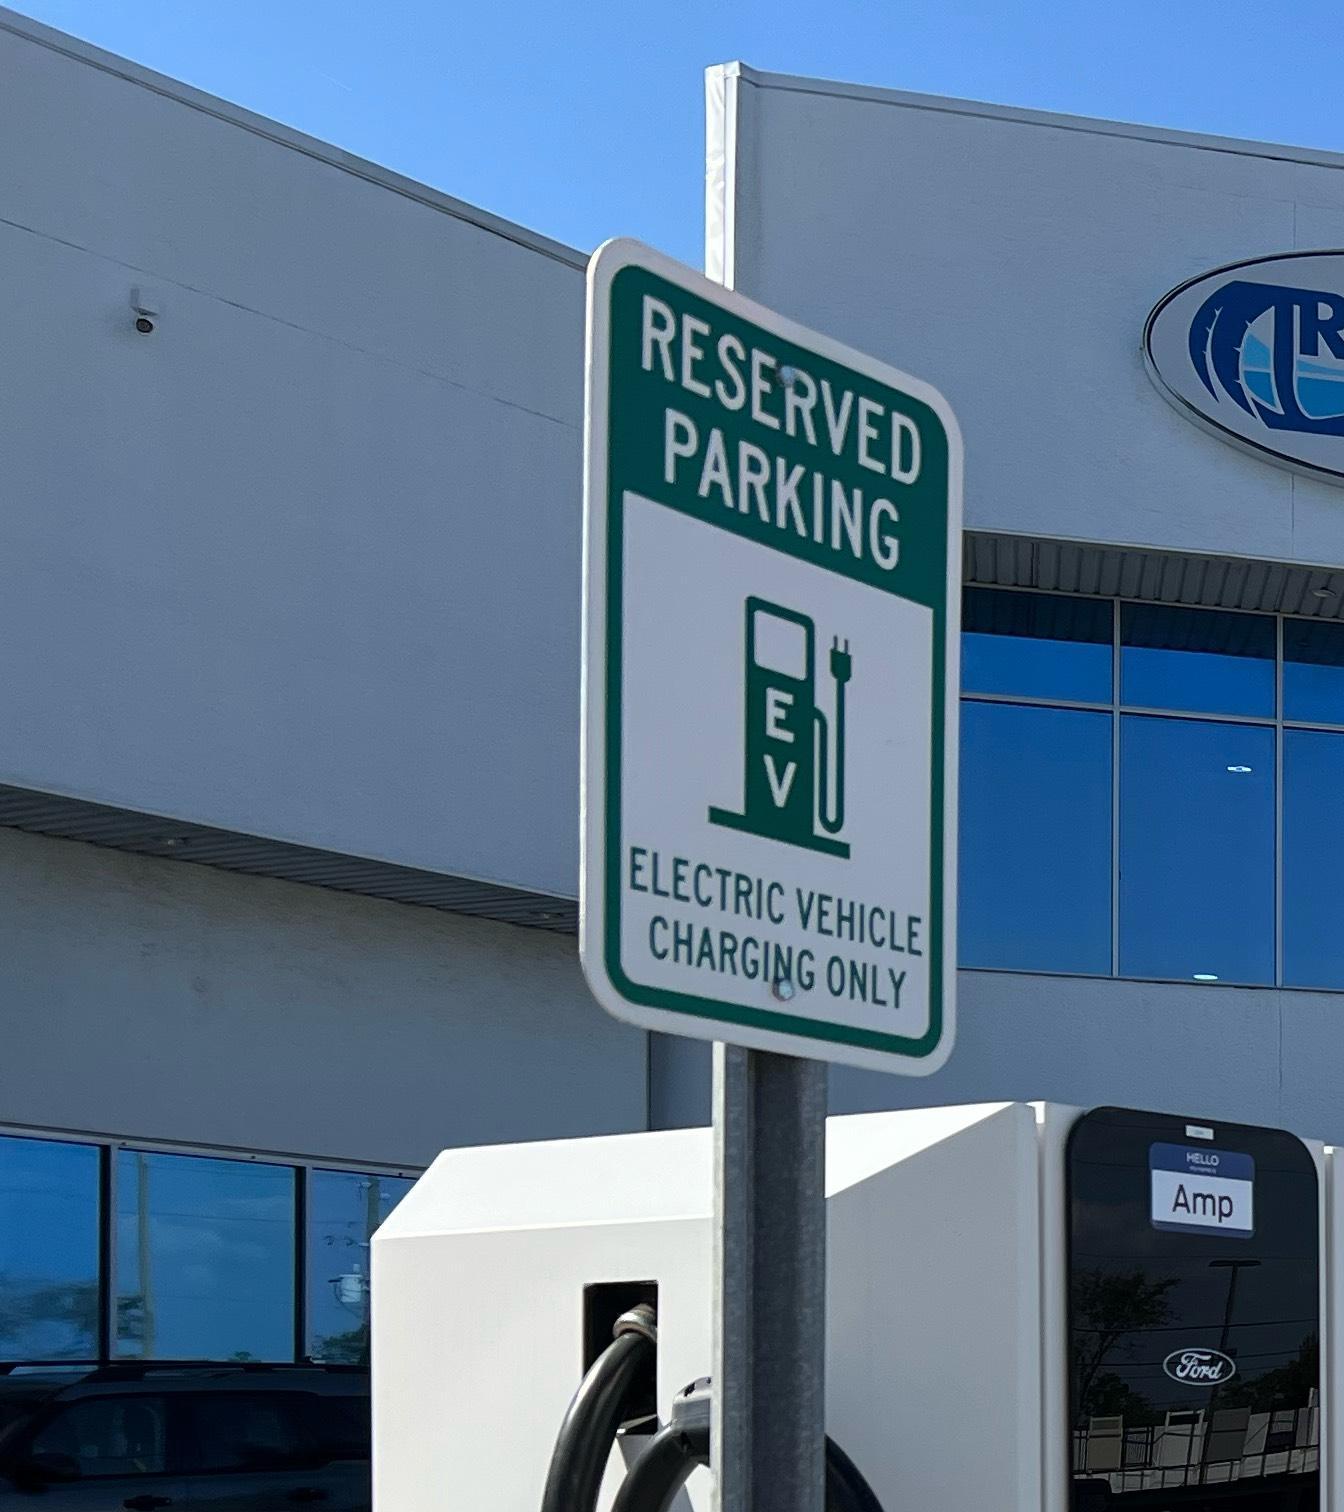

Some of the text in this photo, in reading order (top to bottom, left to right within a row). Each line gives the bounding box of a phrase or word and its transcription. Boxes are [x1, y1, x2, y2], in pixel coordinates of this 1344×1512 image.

[641, 294, 921, 485] RESERVED
[664, 407, 900, 570] PARKING
[629, 846, 923, 957] ELECTRIC VEHICLE
[649, 916, 907, 1009] CHARGING ONLY
[1172, 1184, 1234, 1223] Amp
[1186, 1152, 1219, 1166] HELLO
[1175, 1352, 1224, 1380] Ford
